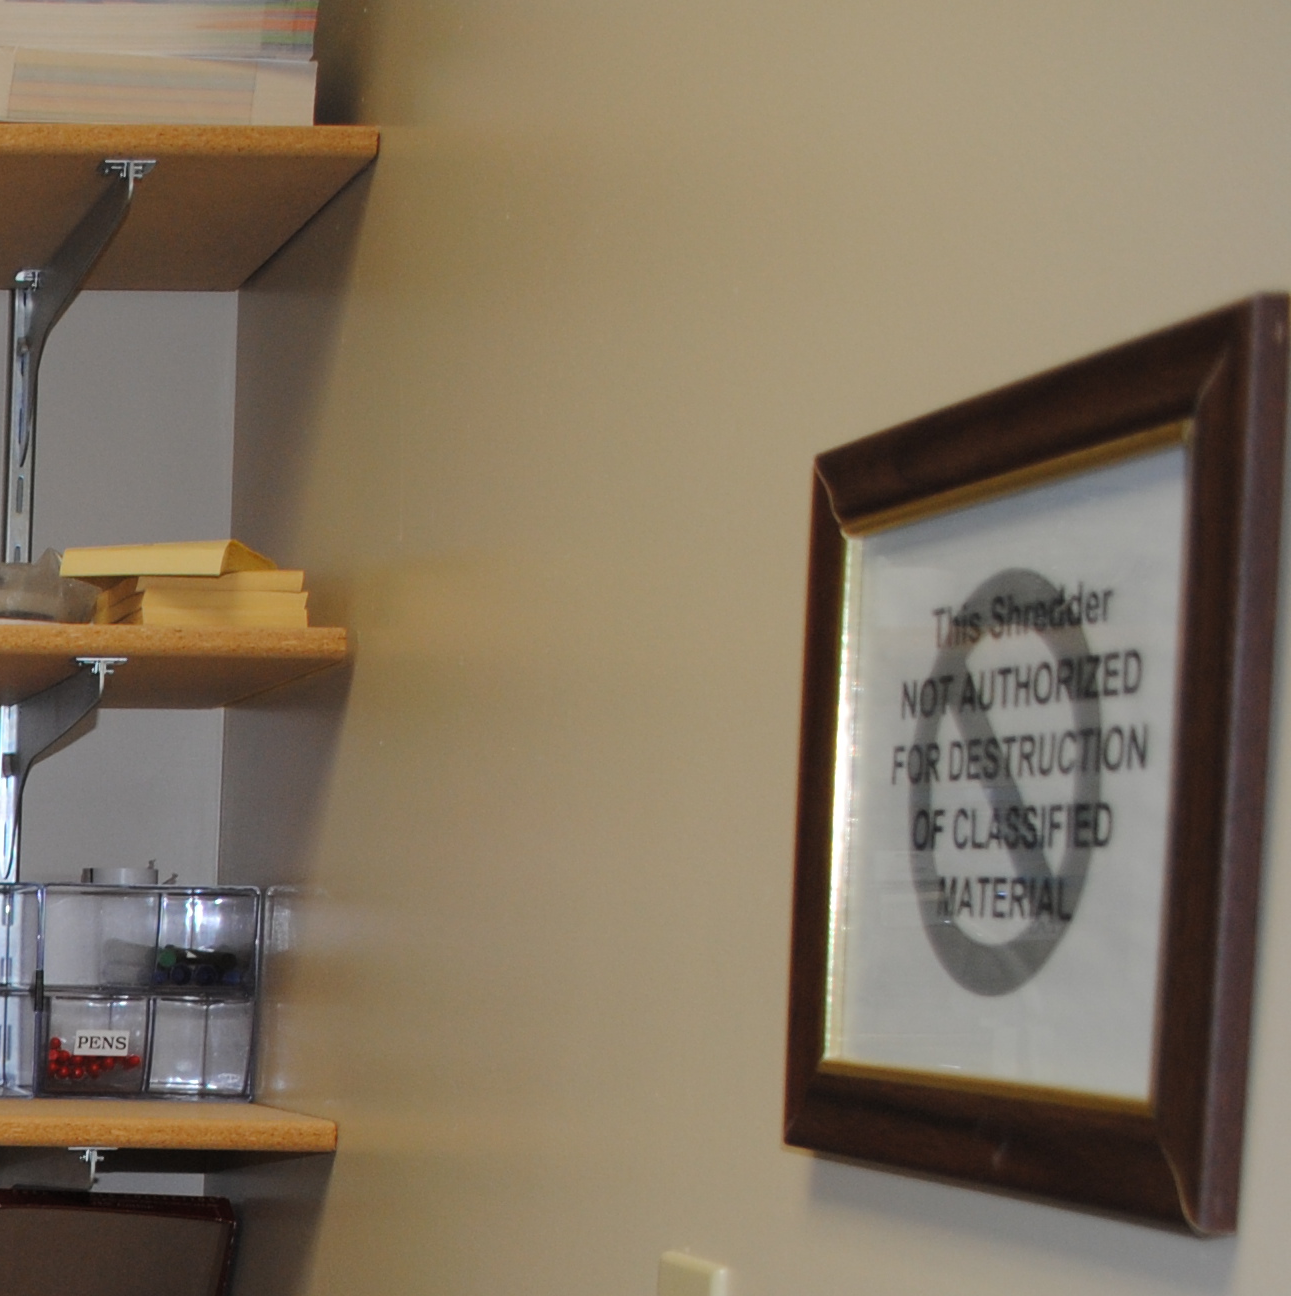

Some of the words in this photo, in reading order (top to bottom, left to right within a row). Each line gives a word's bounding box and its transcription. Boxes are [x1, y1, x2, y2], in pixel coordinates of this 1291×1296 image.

[931, 606, 982, 649] This
[990, 581, 1113, 640] Shredder
[901, 675, 954, 720] NOT
[962, 650, 1143, 713] AUTHORIZED
[891, 742, 940, 785] FOR
[949, 723, 1148, 782] DESTRUCTION
[912, 809, 945, 851] OF
[953, 802, 1113, 850] CLASSIFIED
[938, 877, 1072, 922] MATERIAL
[78, 1036, 127, 1050] PENS
